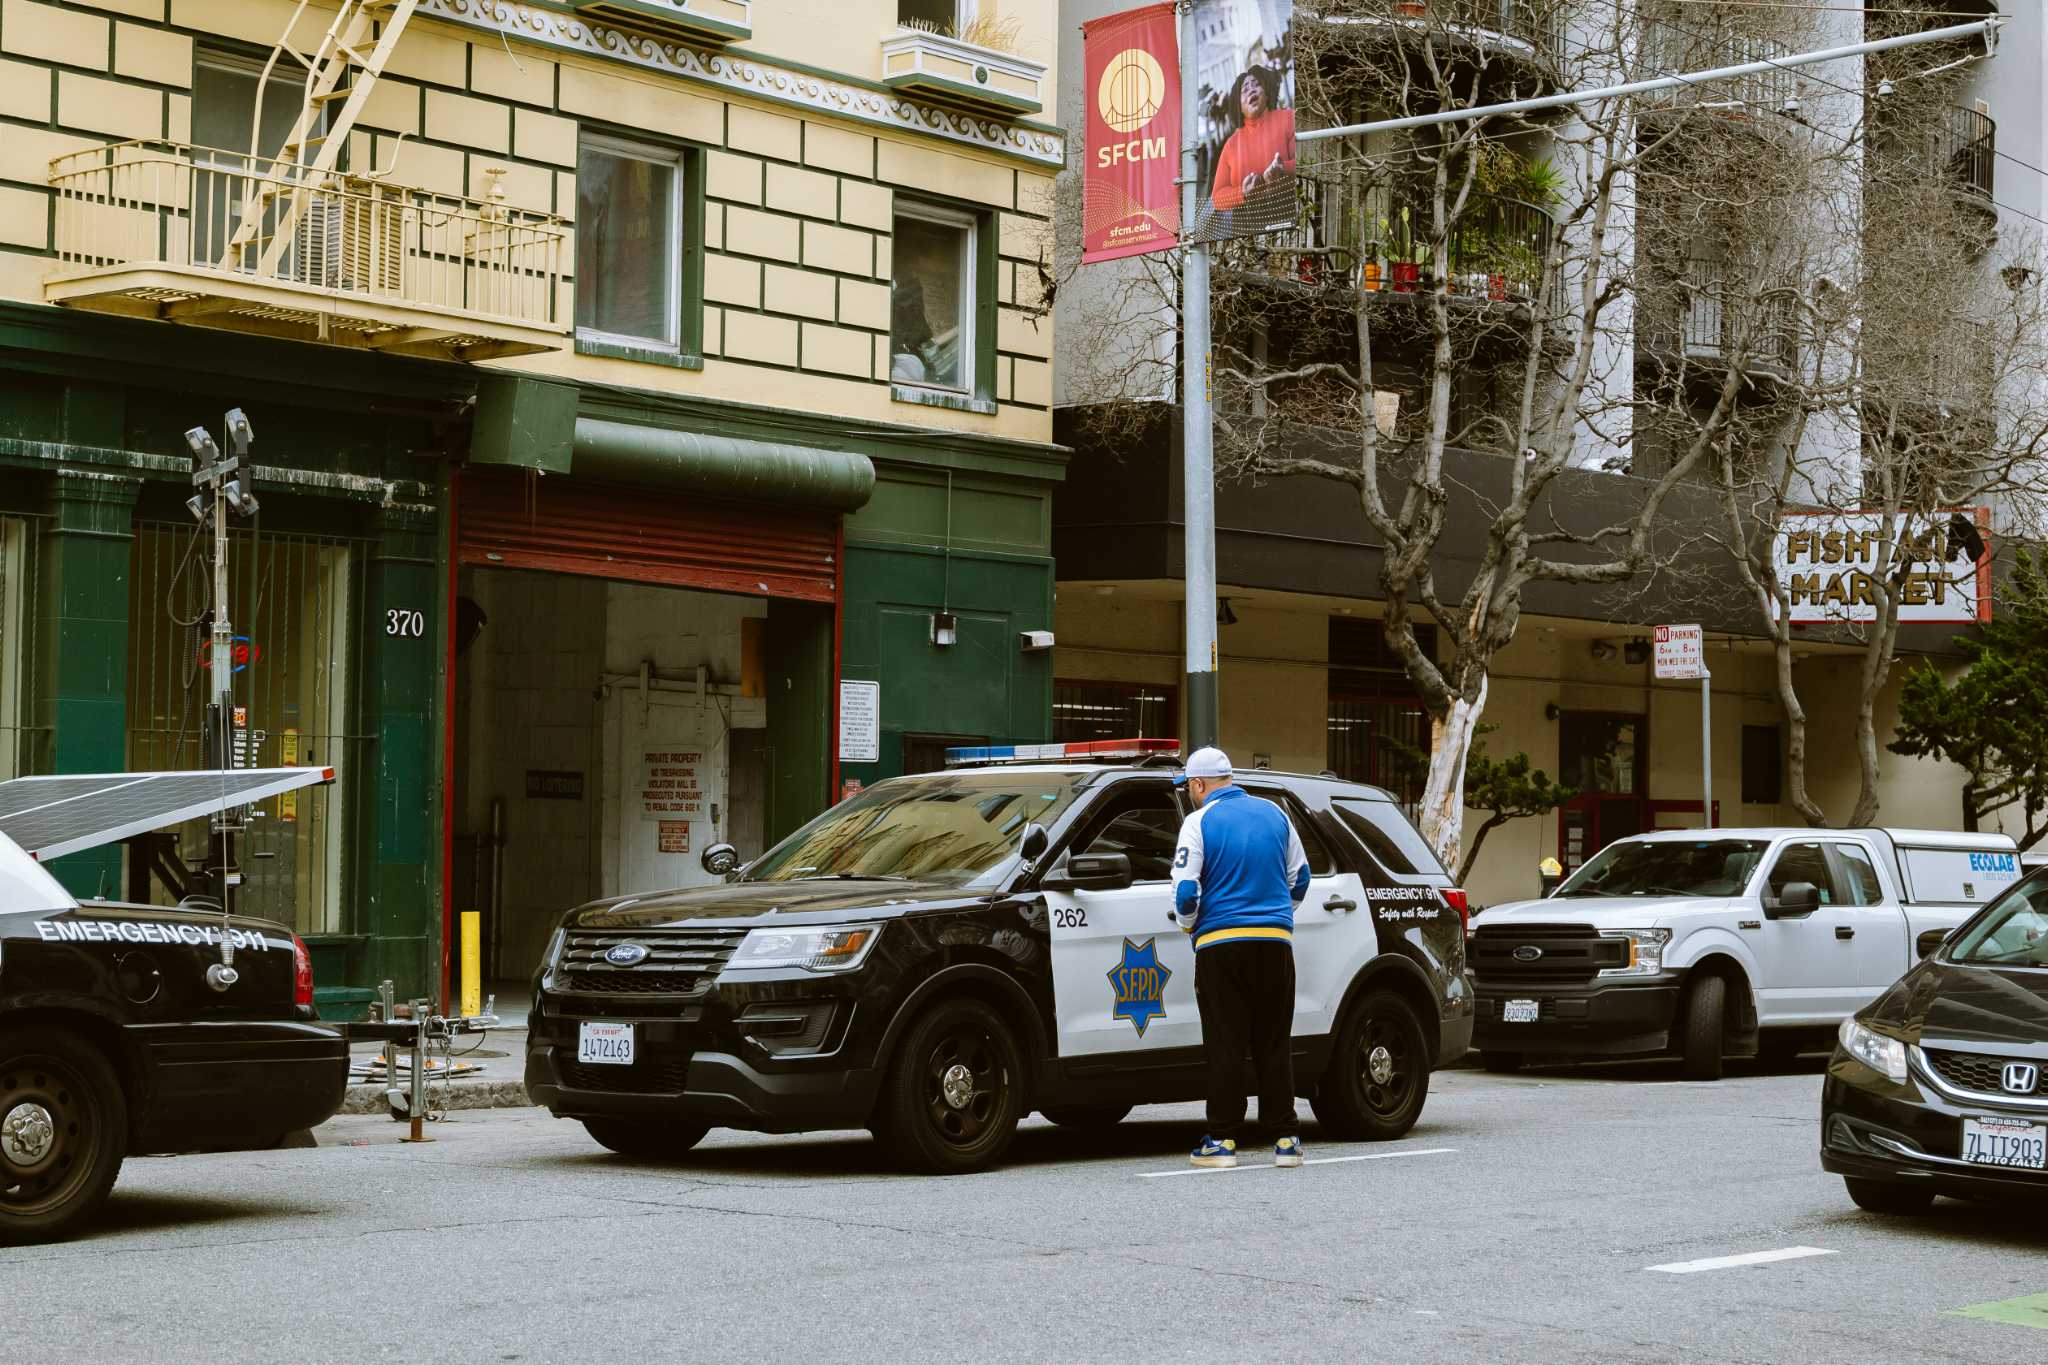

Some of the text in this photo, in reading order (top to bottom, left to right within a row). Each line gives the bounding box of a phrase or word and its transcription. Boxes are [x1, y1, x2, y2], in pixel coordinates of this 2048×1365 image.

[1098, 136, 1166, 168] SFCM
[1110, 222, 1151, 237] sfcm.edu
[1791, 572, 1953, 606] MARET
[387, 609, 424, 637] 370
[1655, 627, 1698, 642] NO PARKING
[670, 753, 703, 763] PROPERTY
[1969, 853, 2015, 872] ECOLAB
[1366, 887, 1423, 900] EMERGENCY
[1054, 908, 1088, 928] 262
[1379, 906, 1440, 921] Safety with Respect
[33, 921, 214, 945] EMERGENCY
[611, 948, 634, 960] Ford
[583, 1038, 630, 1058] 1472163
[1967, 1132, 2043, 1160] 7LTT903
[1962, 1153, 2045, 1169] EZ AUTO SALES
